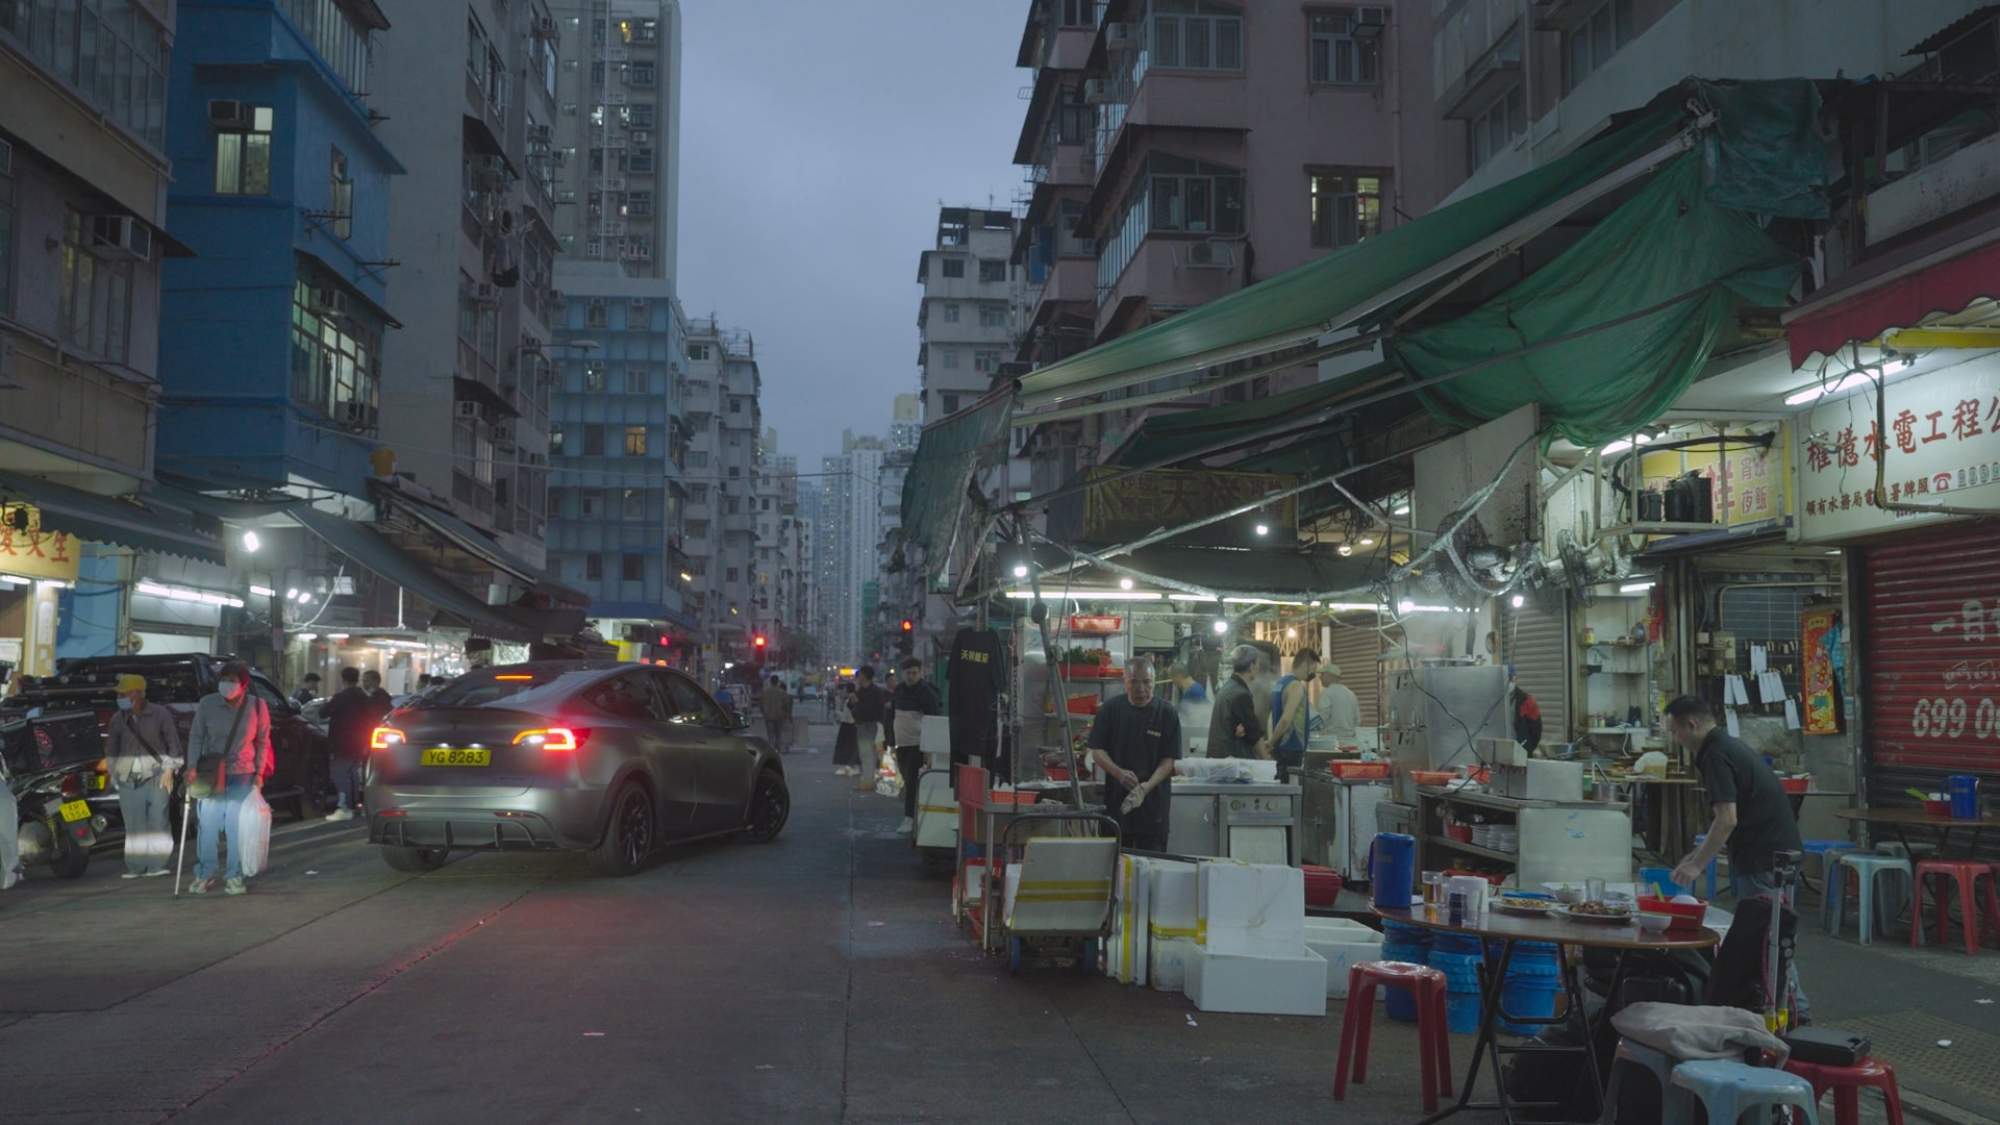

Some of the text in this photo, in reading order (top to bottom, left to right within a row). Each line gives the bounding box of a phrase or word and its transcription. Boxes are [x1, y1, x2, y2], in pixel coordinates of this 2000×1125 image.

[1913, 698, 2000, 740] 699 0
[430, 751, 445, 763] YG
